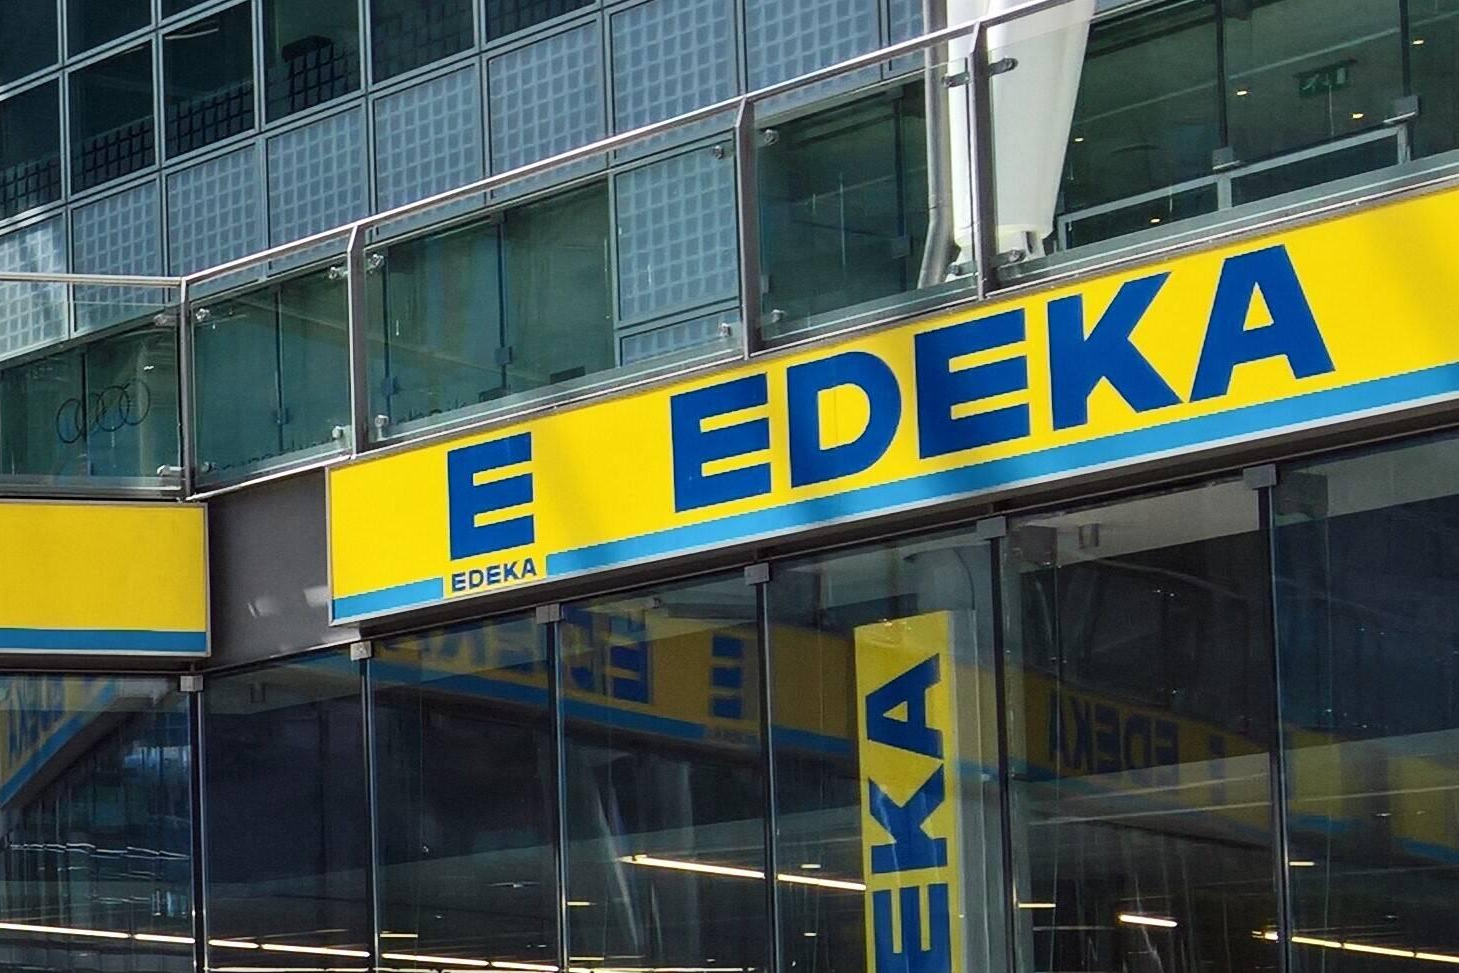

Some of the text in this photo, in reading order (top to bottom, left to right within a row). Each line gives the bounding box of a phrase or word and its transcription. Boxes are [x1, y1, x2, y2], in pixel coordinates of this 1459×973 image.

[670, 244, 1334, 512] EDEKA
[448, 432, 535, 561] E
[451, 557, 537, 592] EDEKA
